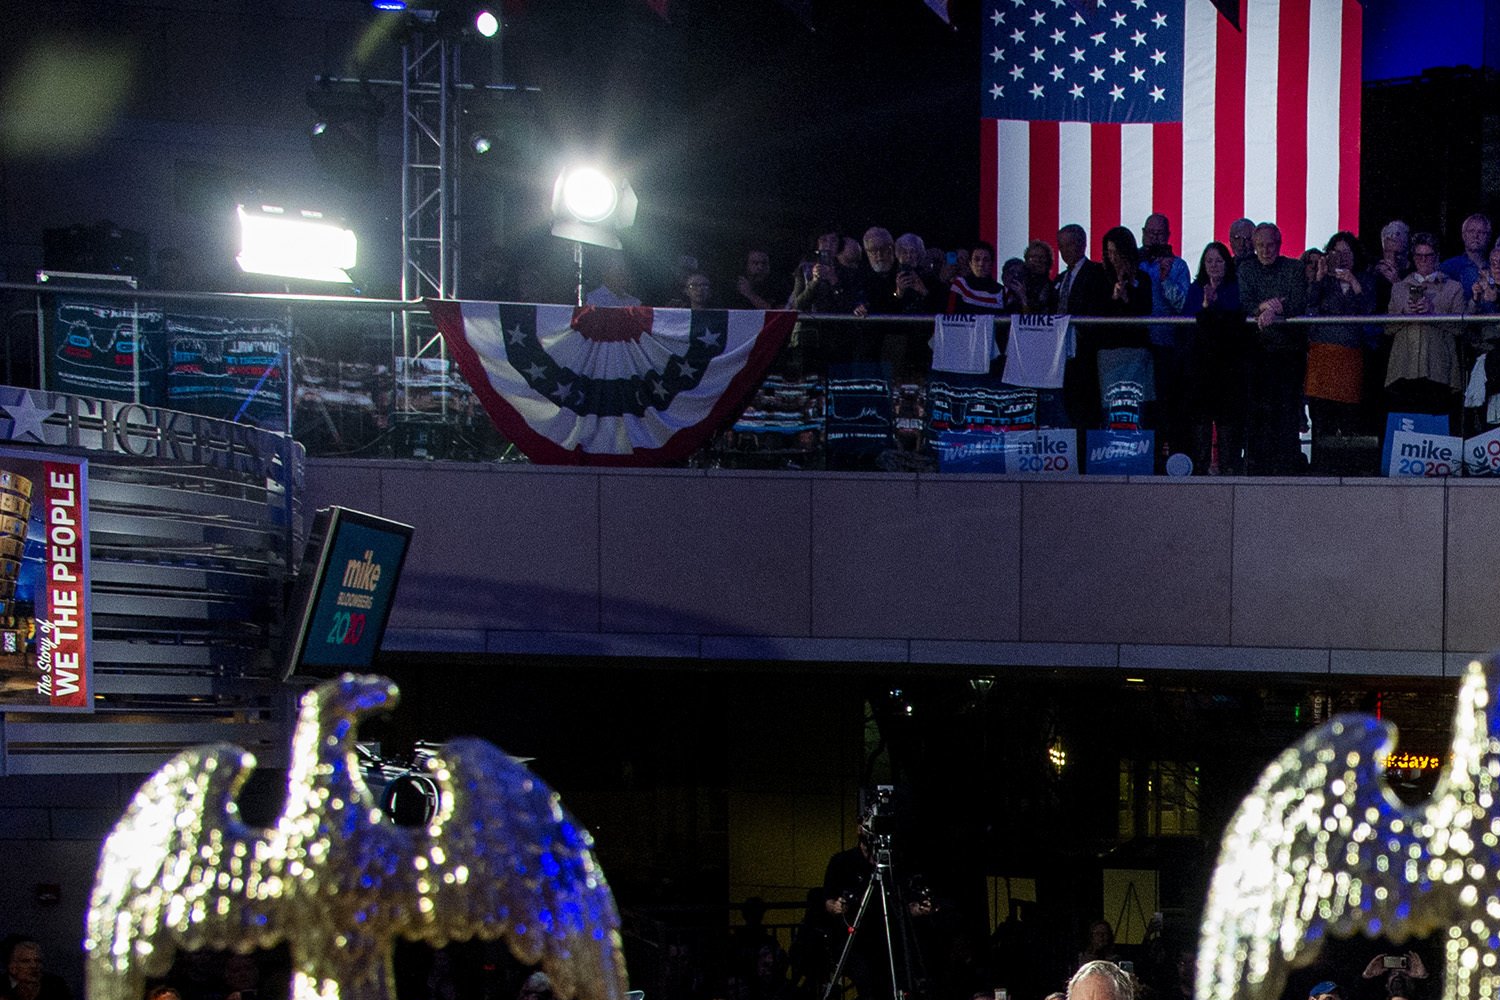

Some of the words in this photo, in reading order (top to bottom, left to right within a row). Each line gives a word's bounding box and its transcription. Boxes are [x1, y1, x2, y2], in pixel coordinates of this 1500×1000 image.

[1018, 313, 1055, 327] MIKE
[1018, 435, 1067, 455] mike
[1401, 440, 1452, 461] mike
[1019, 457, 1068, 472] 2020
[1399, 459, 1451, 477] 2020
[50, 471, 77, 583] PEOPLE
[342, 550, 382, 592] mike
[53, 588, 78, 641] THE
[35, 617, 57, 635] of
[326, 611, 366, 645] 2020
[37, 633, 58, 674] Story
[37, 674, 53, 696] The
[55, 651, 80, 697] WE
